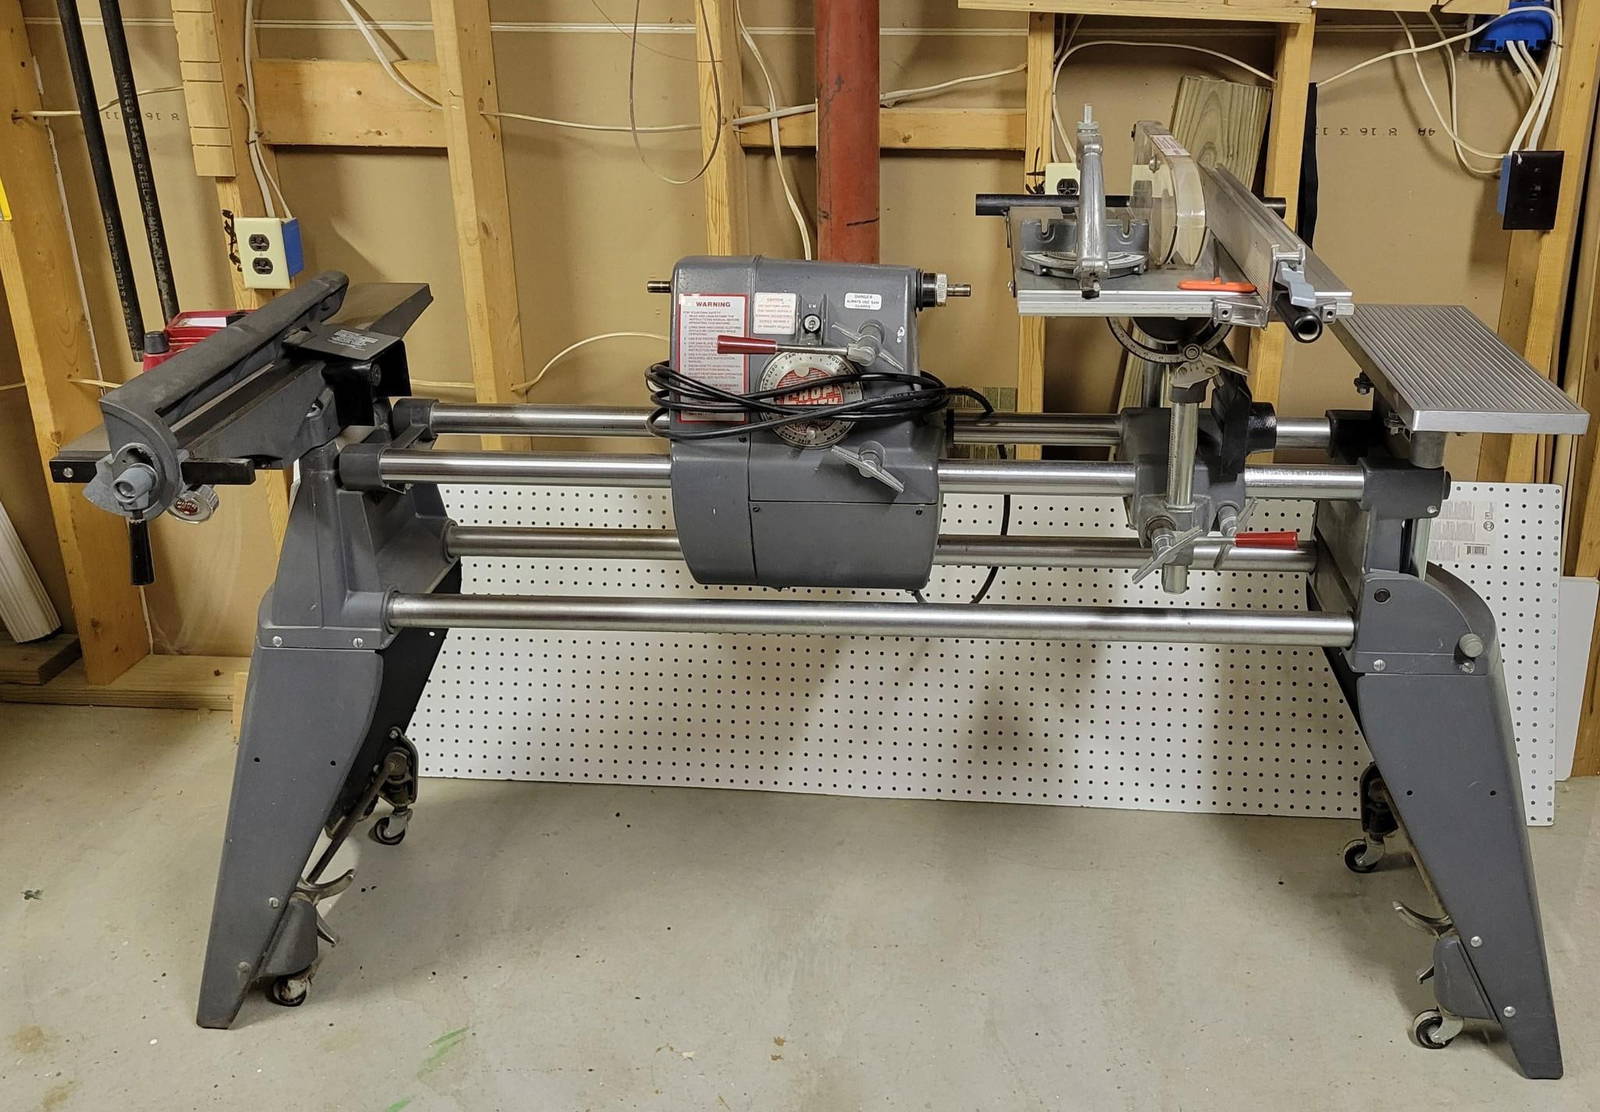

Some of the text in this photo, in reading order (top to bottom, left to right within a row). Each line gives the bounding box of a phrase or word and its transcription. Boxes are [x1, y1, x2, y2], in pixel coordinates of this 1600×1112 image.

[121, 74, 134, 113] UNITED
[1340, 127, 1348, 136] 3
[1360, 127, 1377, 136] 16
[1388, 127, 1398, 136] 8
